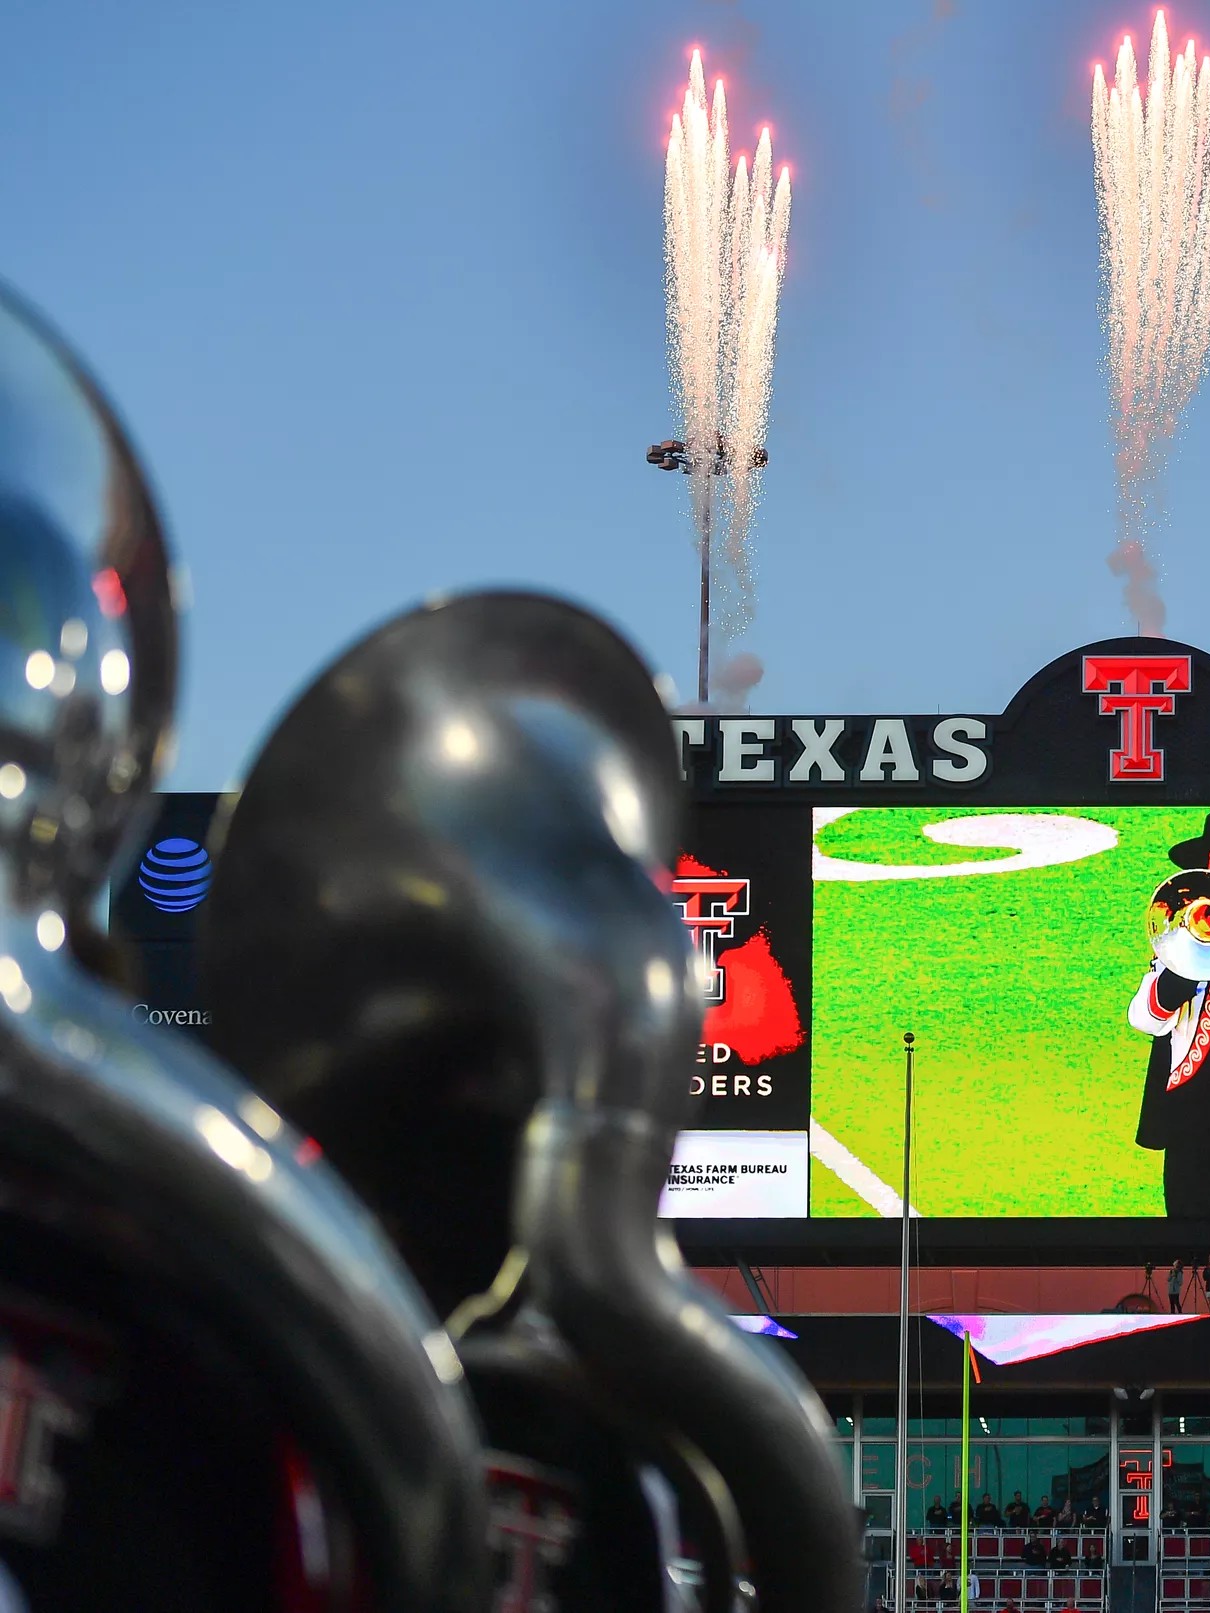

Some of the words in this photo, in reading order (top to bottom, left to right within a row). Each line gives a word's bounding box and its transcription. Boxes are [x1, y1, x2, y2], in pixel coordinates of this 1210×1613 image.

[131, 1003, 213, 1026] Covena
[688, 1074, 773, 1096] DERS
[667, 1175, 735, 1185] INSURANCE
[706, 1164, 738, 1174] FARM
[740, 1164, 787, 1174] BUREAU
[861, 1454, 981, 1489] ECH
